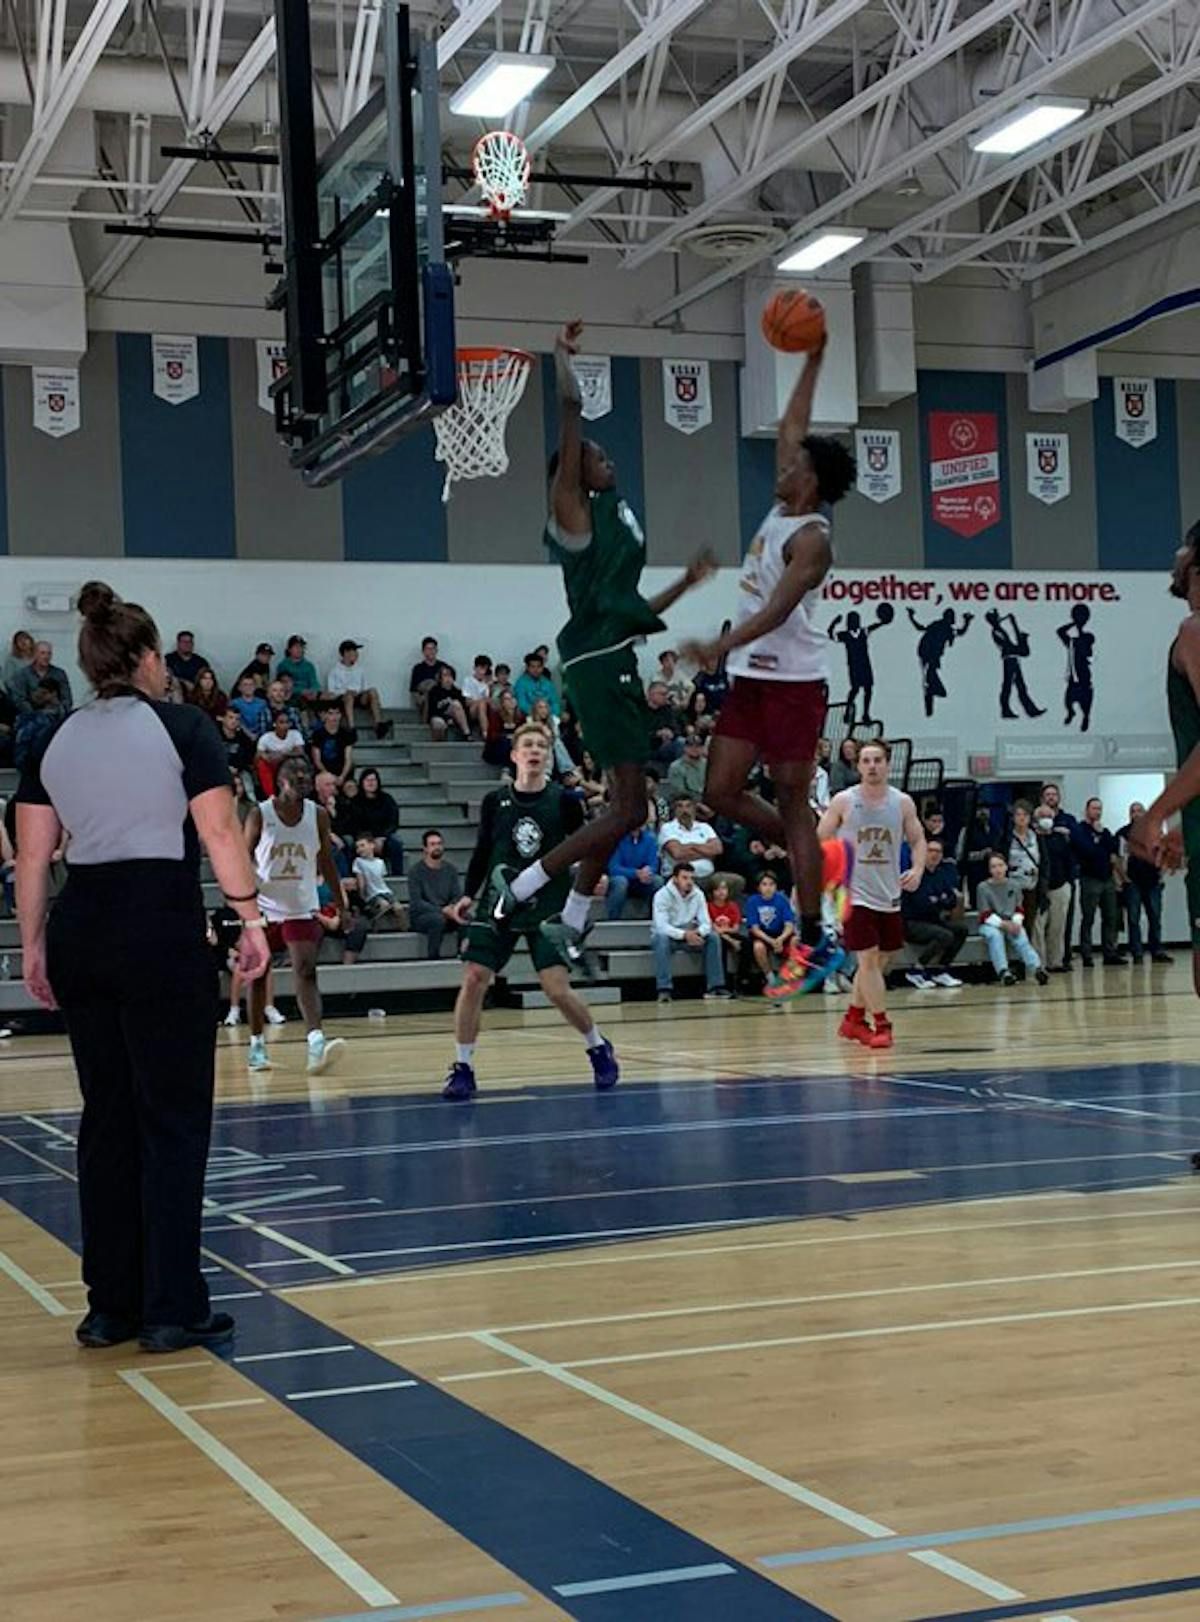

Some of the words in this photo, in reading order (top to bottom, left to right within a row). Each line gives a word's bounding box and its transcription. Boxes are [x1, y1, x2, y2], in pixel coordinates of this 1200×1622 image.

[941, 457, 989, 475] UNIFIED
[949, 581, 989, 600] we
[995, 581, 1040, 600] are
[1045, 581, 1120, 600] more.
